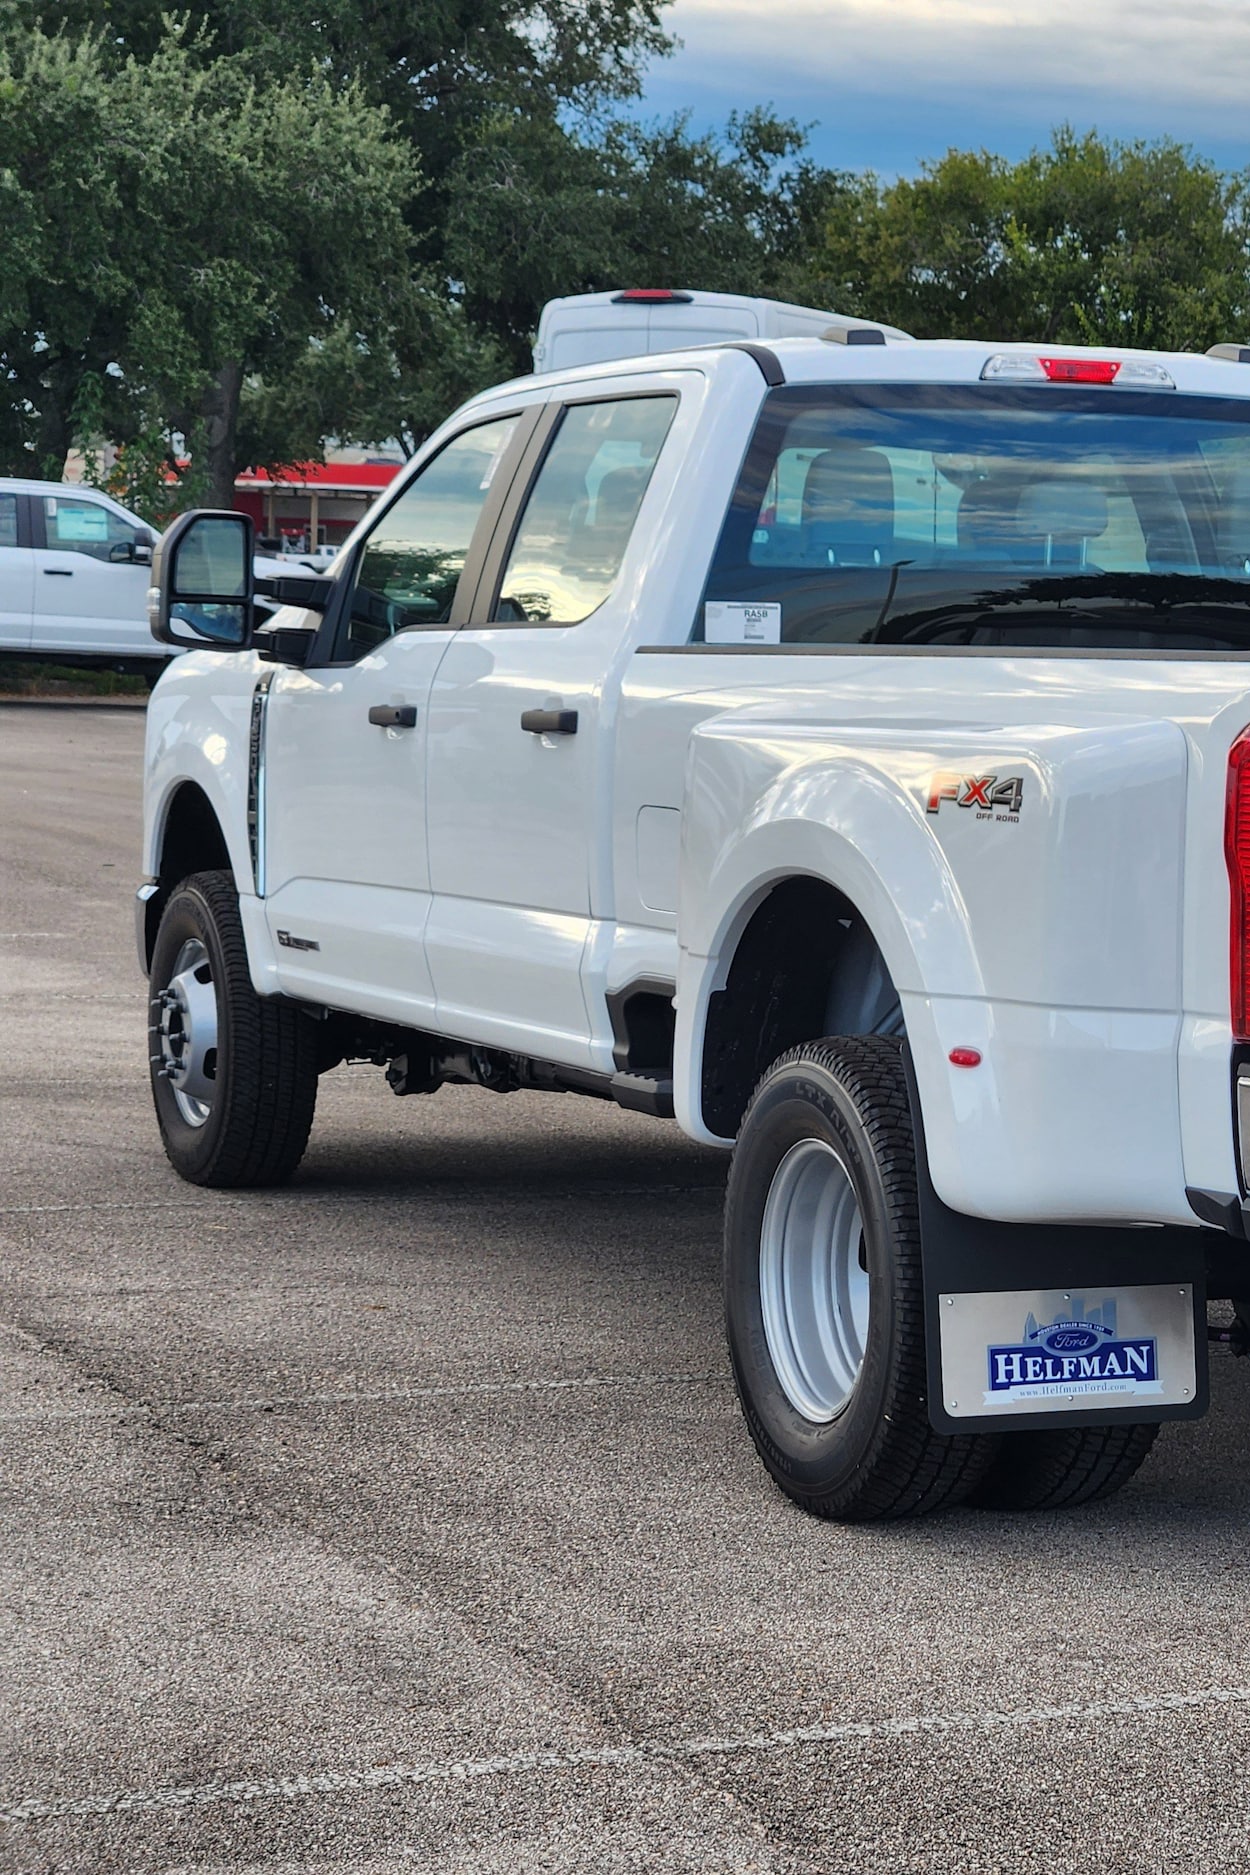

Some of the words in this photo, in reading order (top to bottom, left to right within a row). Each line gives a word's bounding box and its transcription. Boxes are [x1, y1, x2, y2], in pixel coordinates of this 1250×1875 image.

[927, 772, 1024, 813] FX4
[976, 812, 993, 821] OFF
[996, 815, 1019, 823] ROAD
[1054, 1333, 1089, 1348] Ford
[995, 1345, 1150, 1383] HELFMAN
[1020, 1382, 1127, 1396] www.HelfmanFord.com
